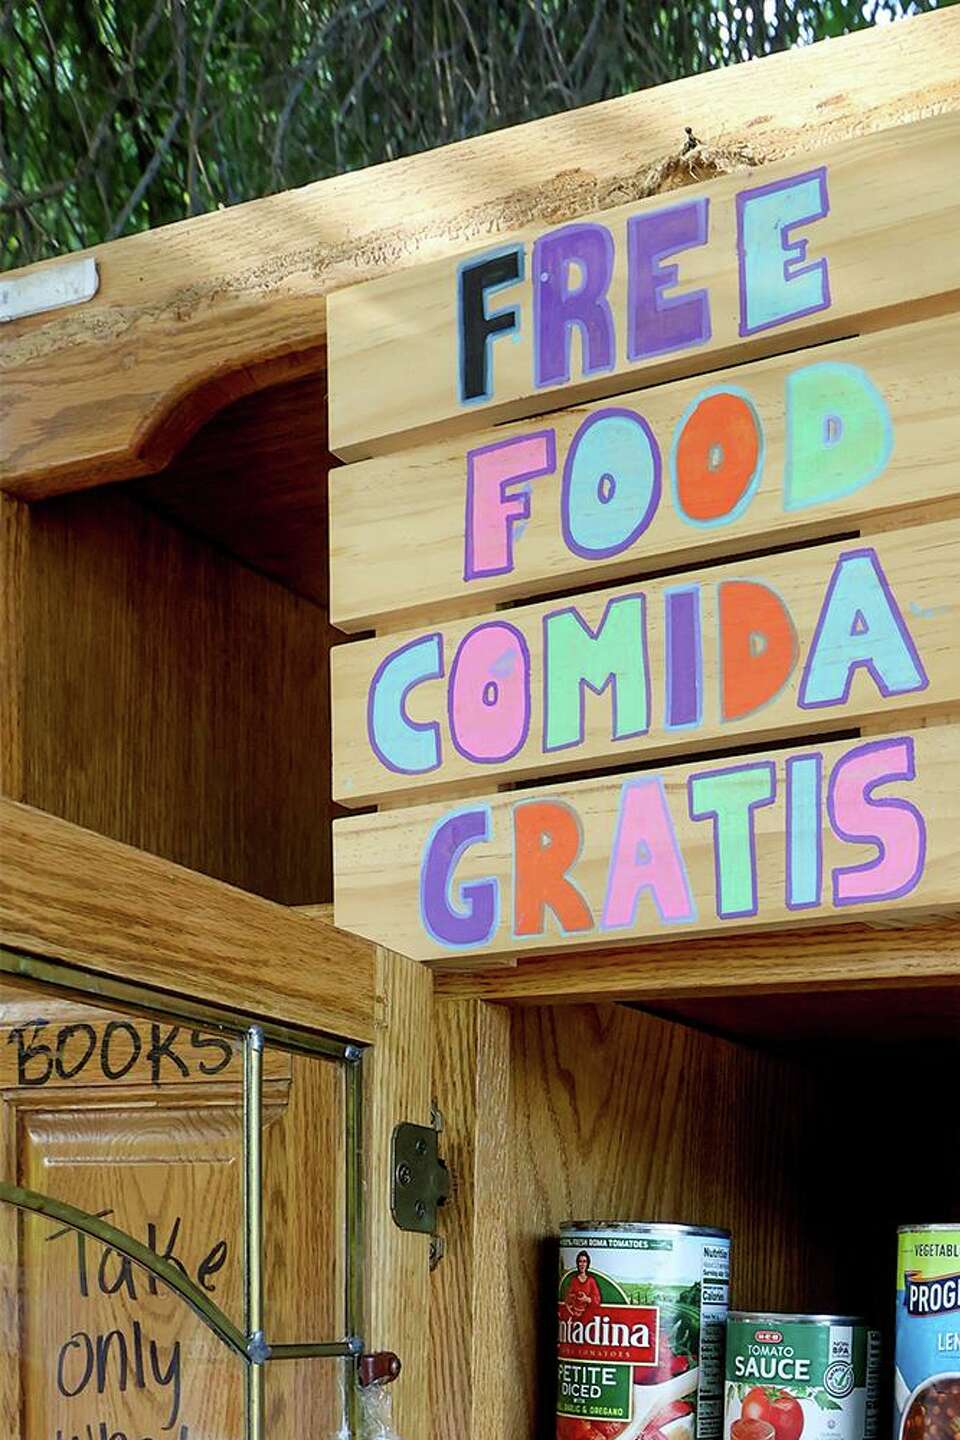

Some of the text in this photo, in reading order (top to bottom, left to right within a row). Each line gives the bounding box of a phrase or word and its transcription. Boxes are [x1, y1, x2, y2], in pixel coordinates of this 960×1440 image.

[457, 167, 831, 408] FREE
[465, 362, 895, 583] FOOD
[367, 548, 929, 775] COMIDA
[419, 737, 926, 949] GRATIS
[8, 1018, 234, 1086] BOOKS
[48, 1209, 229, 1298] Take
[608, 1240, 649, 1249] TOMATOES
[56, 1320, 182, 1430] only
[559, 1365, 617, 1386] PETITE
[561, 1382, 602, 1398] DICED
[735, 1356, 811, 1381] SAUCE
[748, 1345, 794, 1357] TOMATO
